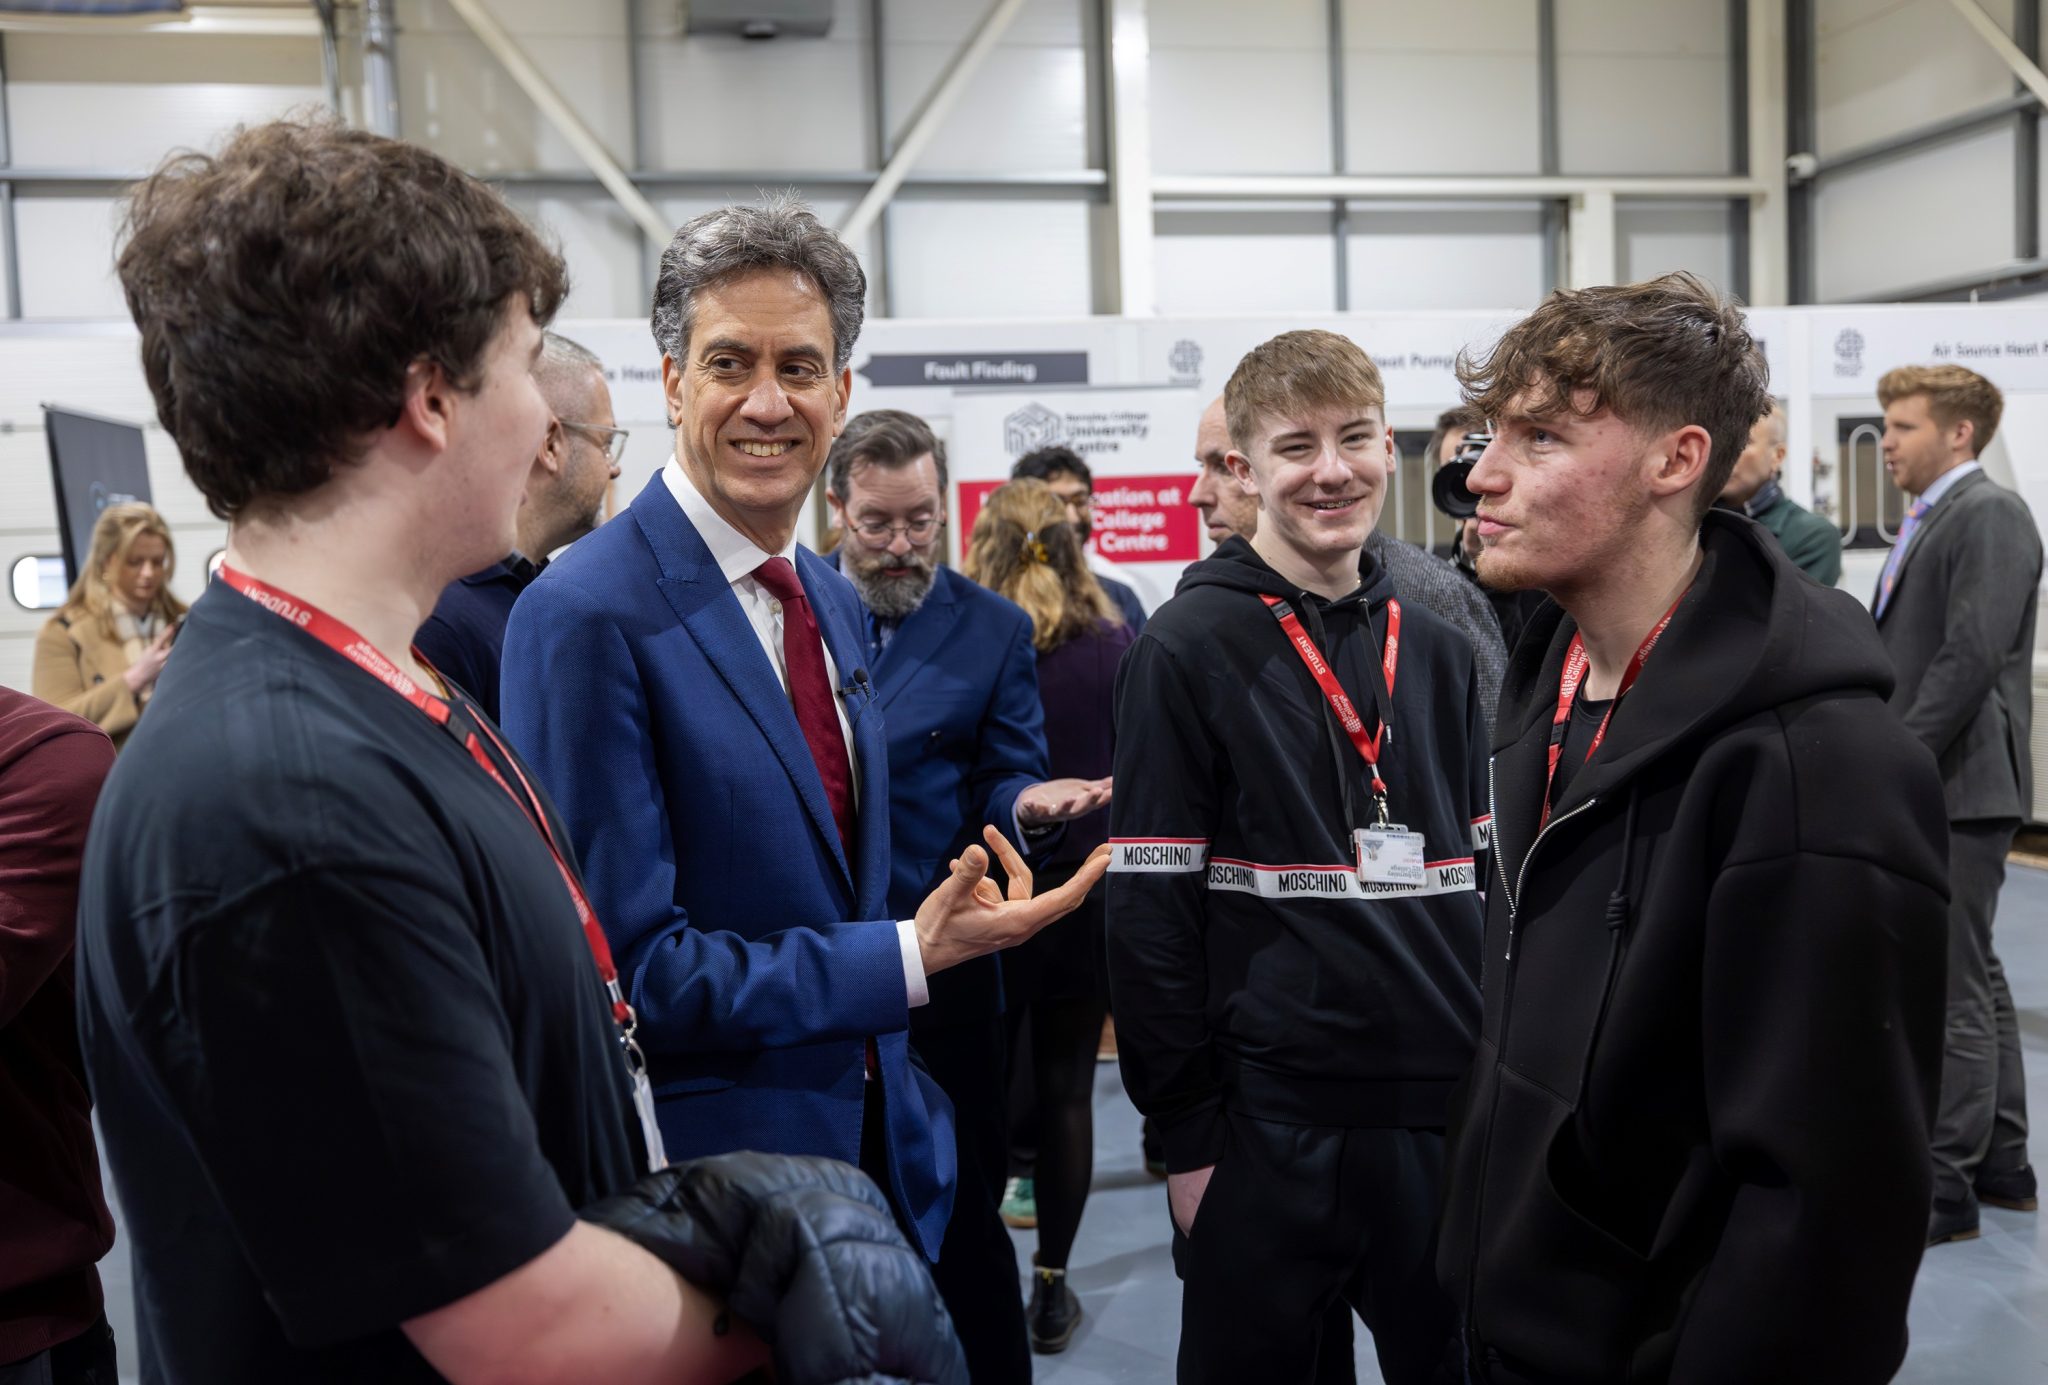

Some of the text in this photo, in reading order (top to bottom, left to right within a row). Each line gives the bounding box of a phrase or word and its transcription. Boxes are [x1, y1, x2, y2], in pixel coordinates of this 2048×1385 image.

[1932, 342, 1951, 358] Air
[1956, 341, 2000, 358] Source
[2005, 340, 2038, 357] Heat
[923, 359, 1038, 383] Fault Finding
[1066, 422, 1148, 442] University
[1157, 487, 1181, 507] at
[1090, 508, 1166, 533] College
[1100, 530, 1168, 554] Centre
[1295, 636, 1326, 675] STUDENT
[1563, 644, 1583, 681] Barnsley
[1570, 652, 1588, 681] College
[1331, 694, 1350, 722] Barnsley
[1337, 694, 1356, 720] College
[1123, 846, 1191, 867] MOSCHINO
[1209, 864, 1255, 889] OSCHINO
[1278, 872, 1347, 893] MOSCHINO
